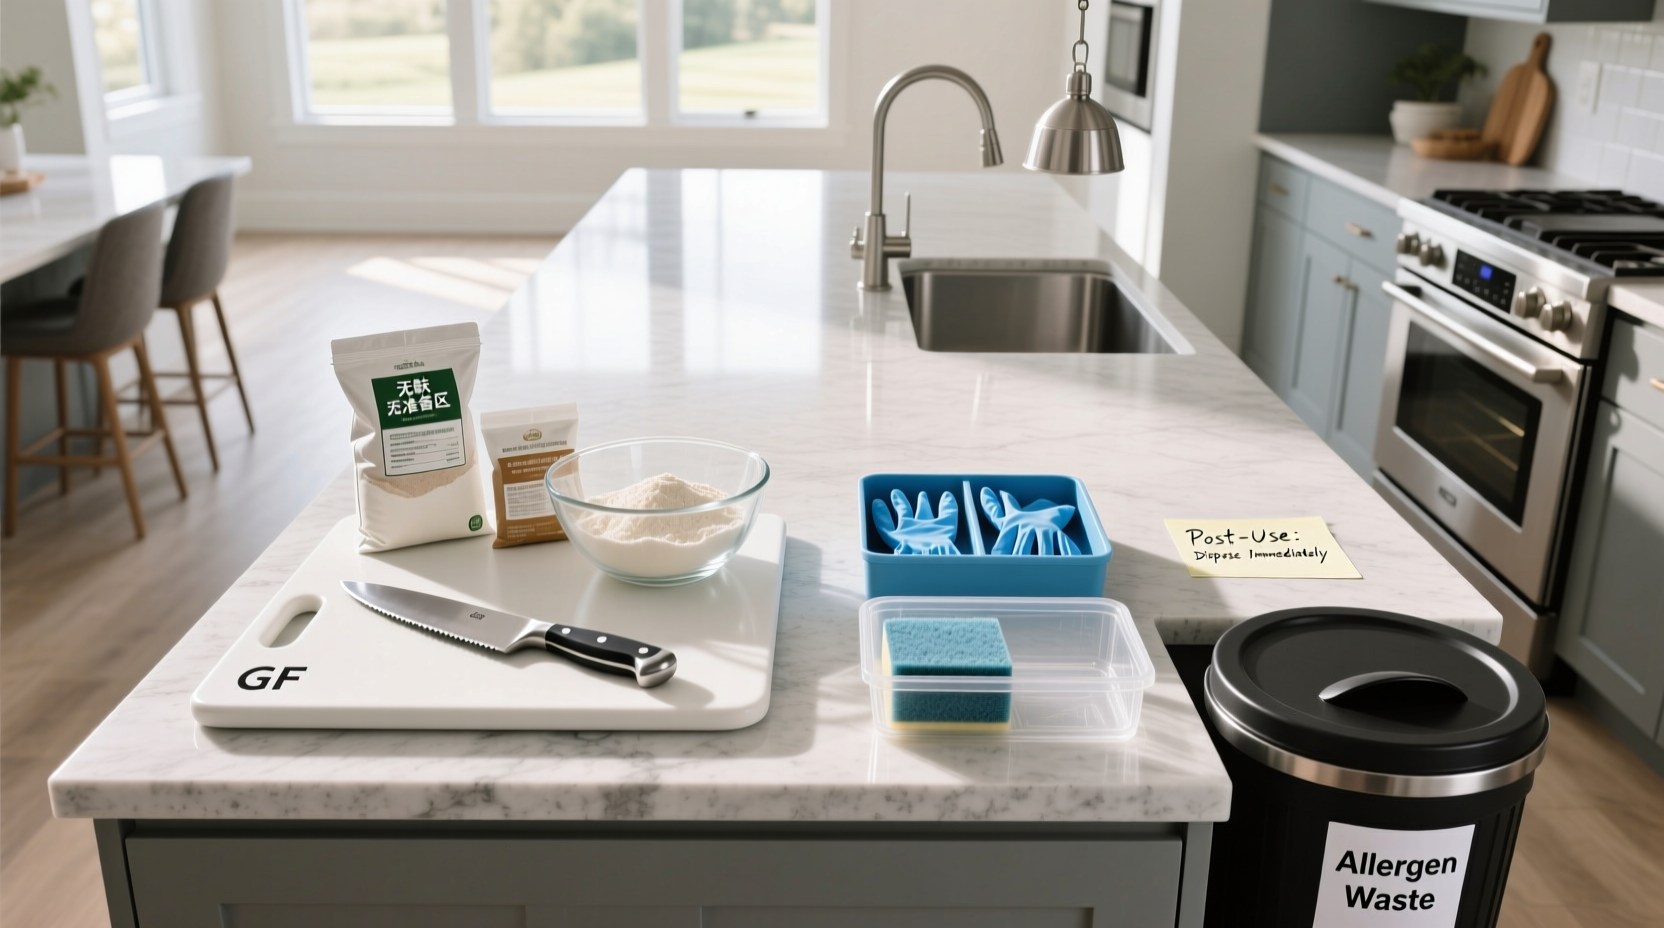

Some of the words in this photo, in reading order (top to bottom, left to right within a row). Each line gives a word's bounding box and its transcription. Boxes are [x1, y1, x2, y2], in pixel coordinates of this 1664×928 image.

[1185, 528, 1300, 546] Post-Use:
[237, 665, 308, 691] GF
[1335, 850, 1457, 882] Allergen
[1345, 884, 1435, 911] Waste
